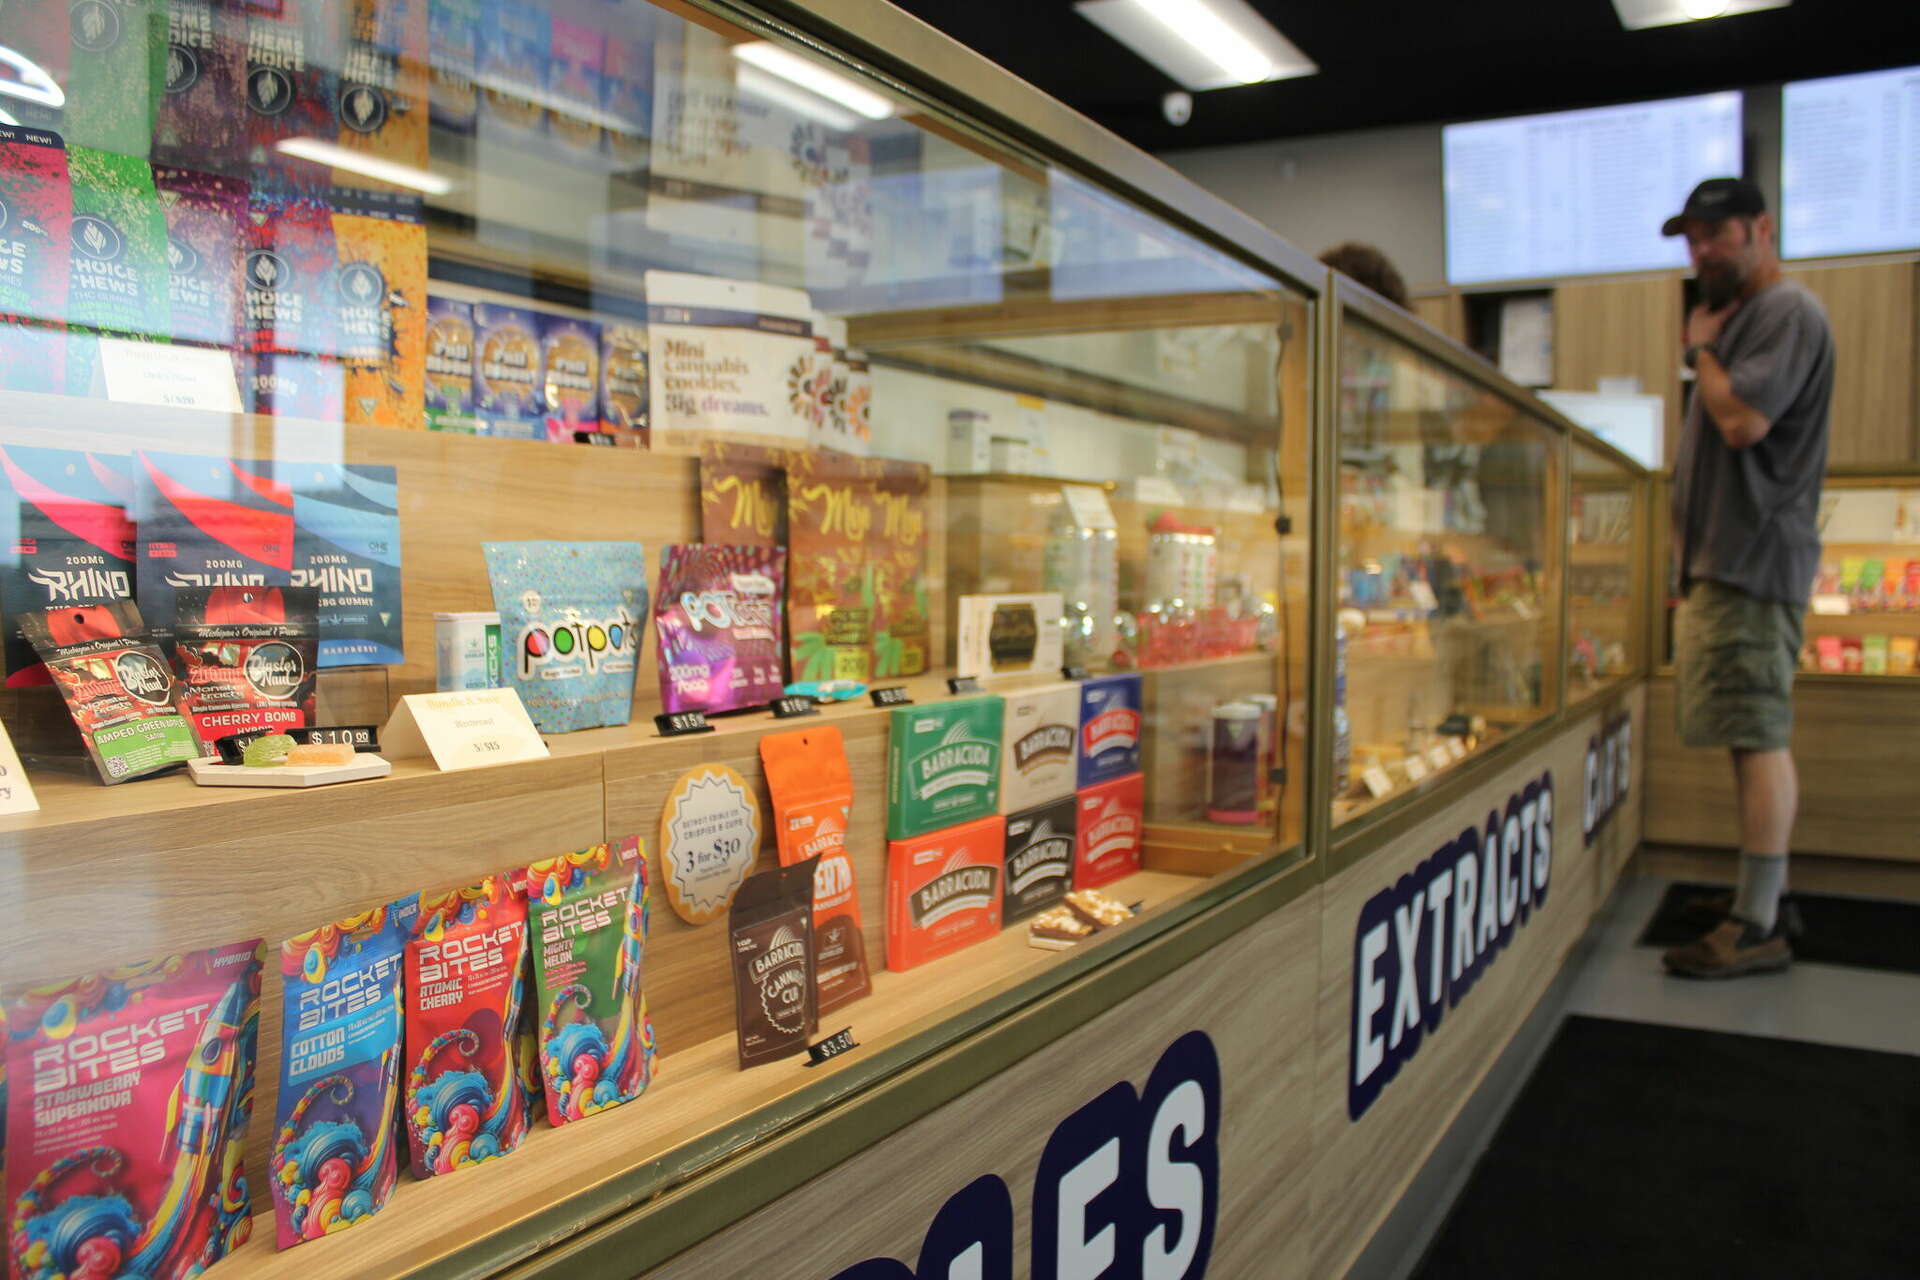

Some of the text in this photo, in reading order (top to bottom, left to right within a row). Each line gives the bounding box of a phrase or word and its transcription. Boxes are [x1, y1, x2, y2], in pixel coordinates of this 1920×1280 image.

[25, 134, 52, 145] NEW!
[70, 258, 139, 282] HOICE
[72, 275, 139, 297] HEWS
[65, 555, 105, 566] 200MG
[205, 559, 243, 569] 200MG
[309, 555, 348, 565] 200MG
[28, 567, 131, 602] RHINO
[201, 711, 297, 727] CHERRY BOMB
[97, 727, 135, 745] AMPED
[922, 744, 990, 780] BARRACUDA
[685, 850, 695, 873] 3
[922, 868, 990, 911] BARRACUDA
[541, 887, 628, 927] ROCKET
[419, 920, 522, 965] ROCKET
[542, 909, 612, 944] BITES
[1355, 789, 1554, 1087] EXTRACTS
[543, 938, 575, 957] MIGHTY
[543, 950, 573, 969] MELON
[419, 946, 503, 984] BITES
[300, 952, 403, 1011] ROCKET
[419, 977, 463, 998] ATOMIC
[299, 983, 382, 1032] BITES
[420, 990, 463, 1012] CHERRY
[33, 1003, 209, 1070] ROCKET
[290, 1027, 345, 1060] COTTON
[820, 1031, 854, 1057] $3.50
[33, 1039, 166, 1094] BITES
[289, 1046, 345, 1077] CLOUDS
[33, 1070, 141, 1111] STRAWBERRY
[33, 1089, 133, 1129] SUPERNOVA
